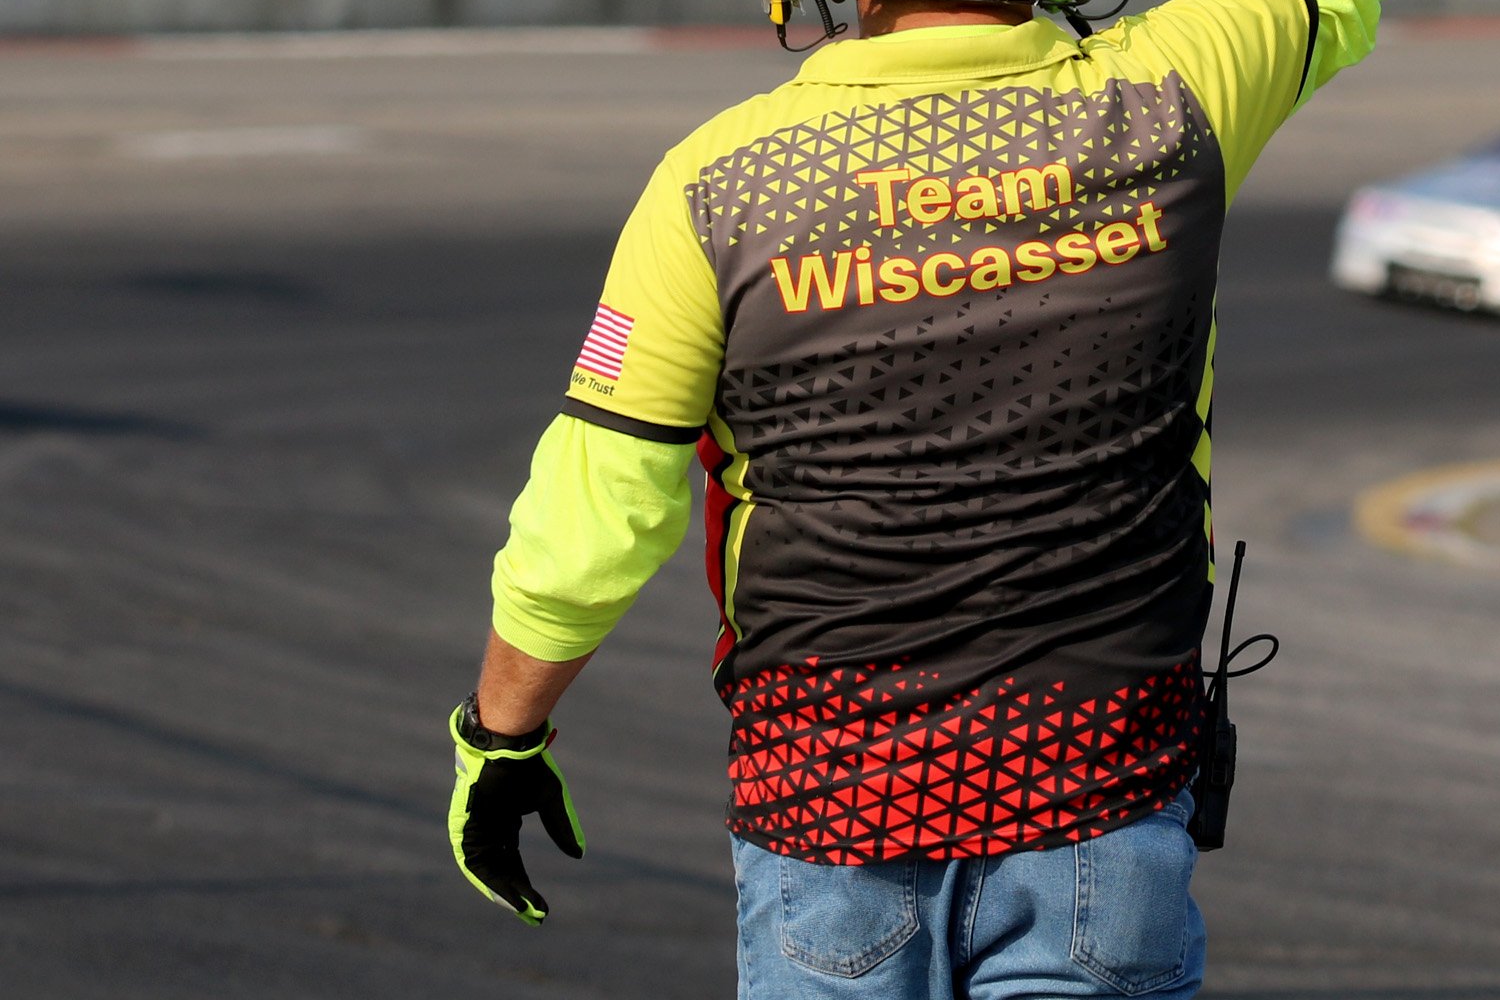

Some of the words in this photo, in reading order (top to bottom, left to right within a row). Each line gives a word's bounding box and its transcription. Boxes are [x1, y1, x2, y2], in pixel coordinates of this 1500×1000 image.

[857, 163, 1074, 228] Team
[770, 201, 1168, 313] Wiscasset
[572, 372, 586, 385] We
[588, 378, 615, 396] Trust
